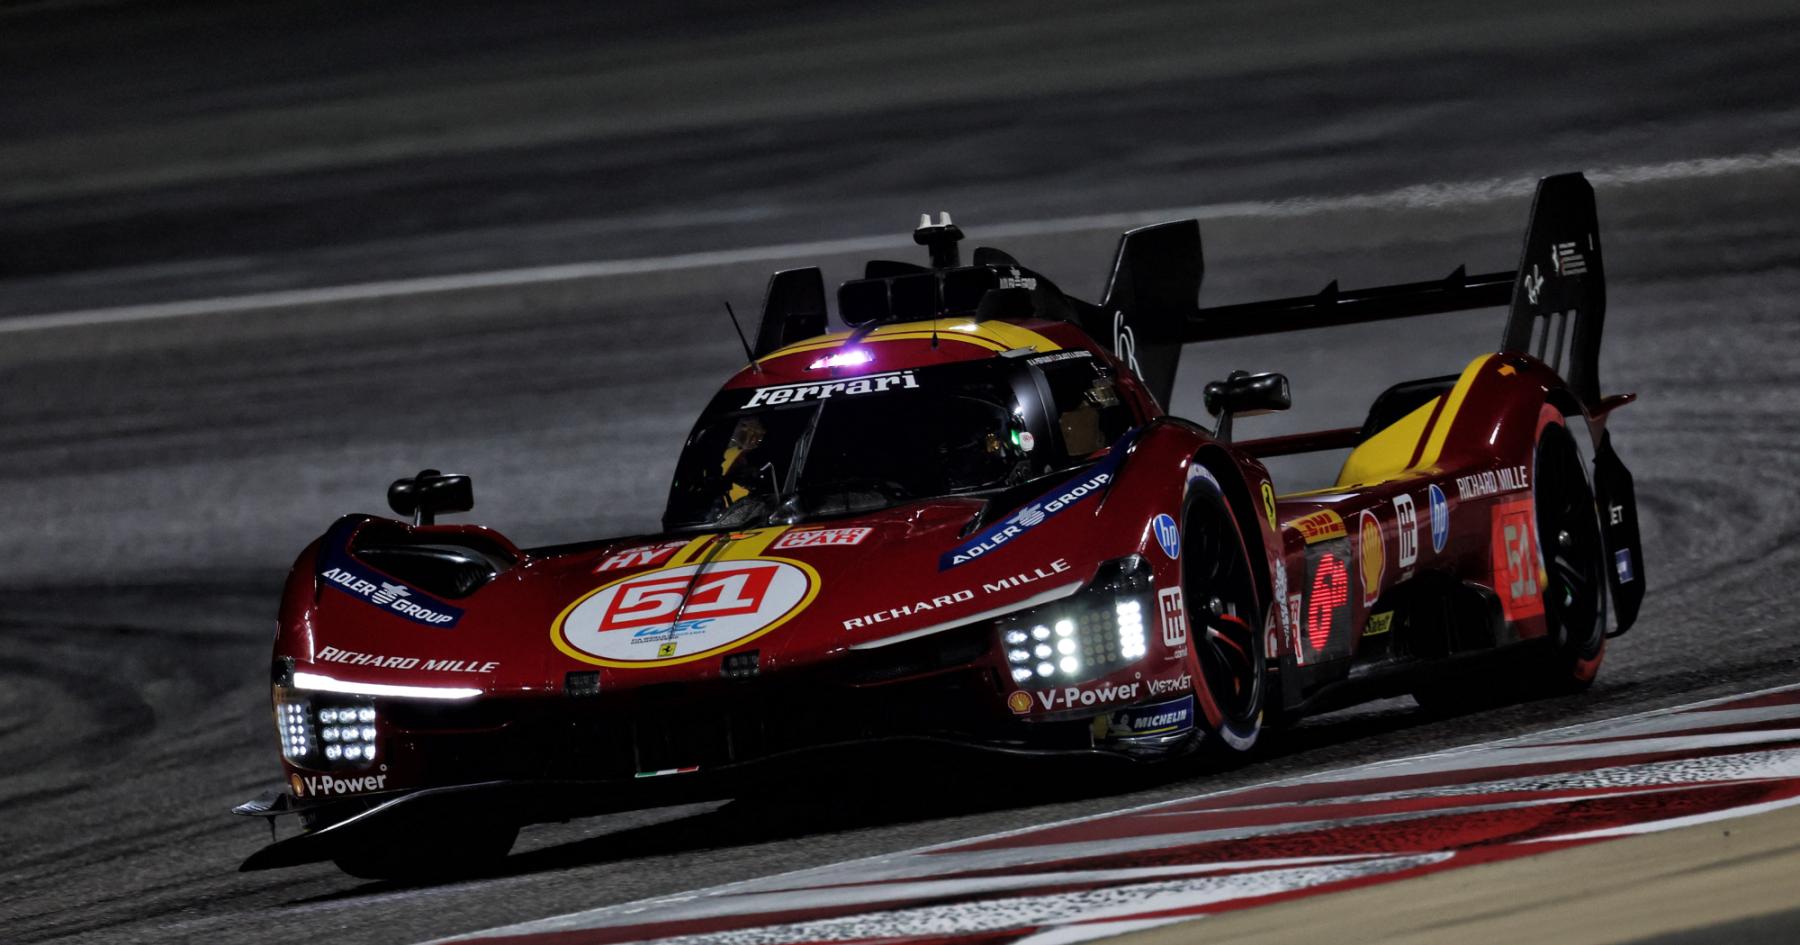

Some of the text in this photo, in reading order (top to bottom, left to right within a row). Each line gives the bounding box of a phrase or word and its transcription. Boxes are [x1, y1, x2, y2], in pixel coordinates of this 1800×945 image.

[740, 370, 920, 410] Ferrari
[1455, 465, 1529, 503] RICHARD MILLE
[952, 472, 1112, 565] ADLER GROUP
[1159, 515, 1178, 558] hp
[1297, 511, 1341, 537] DHL
[1432, 488, 1447, 552] hp
[1503, 523, 1538, 599] 51
[321, 567, 453, 624] ADLER GROUP
[610, 573, 755, 624] 51
[842, 558, 1071, 631] RICHARD MILLE
[634, 619, 716, 638] WEC
[316, 646, 500, 673] RICHARD MILLE
[1037, 678, 1140, 711] V-Power
[1134, 708, 1188, 729] MICHELIN
[303, 773, 388, 797] V-Power
